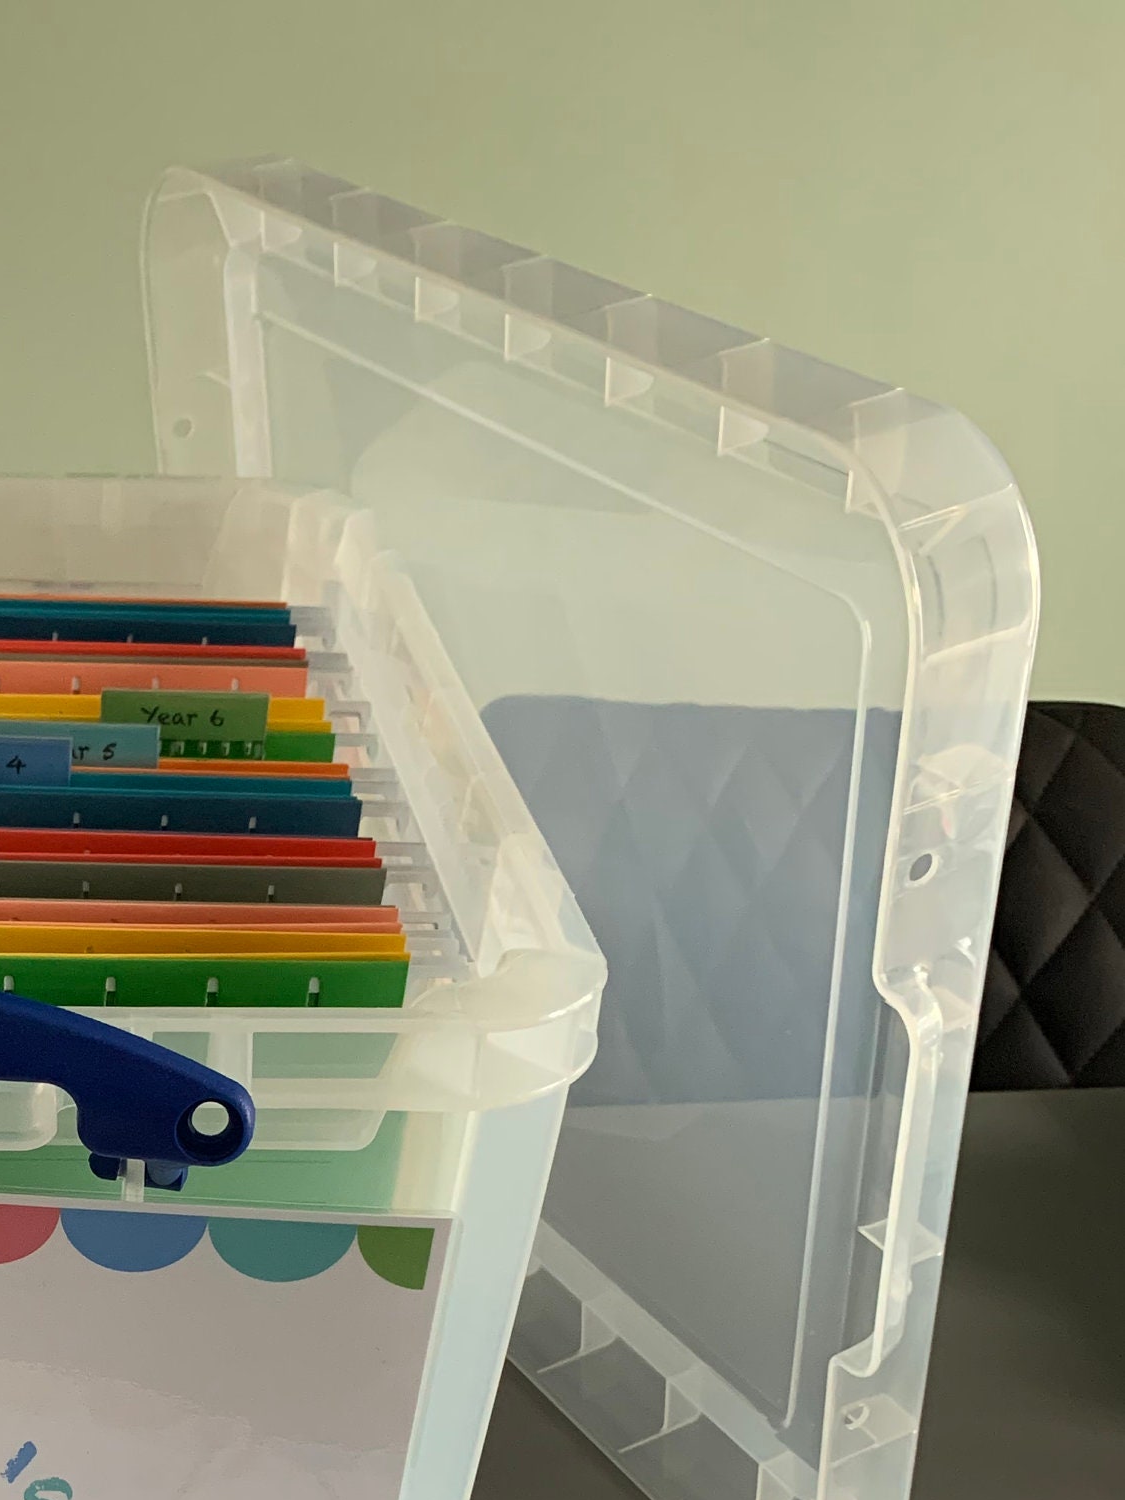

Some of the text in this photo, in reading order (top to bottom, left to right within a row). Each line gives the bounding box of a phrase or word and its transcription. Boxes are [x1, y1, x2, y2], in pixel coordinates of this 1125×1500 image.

[141, 706, 225, 727] Year 6
[102, 742, 117, 761] 5
[5, 755, 27, 775] 4
